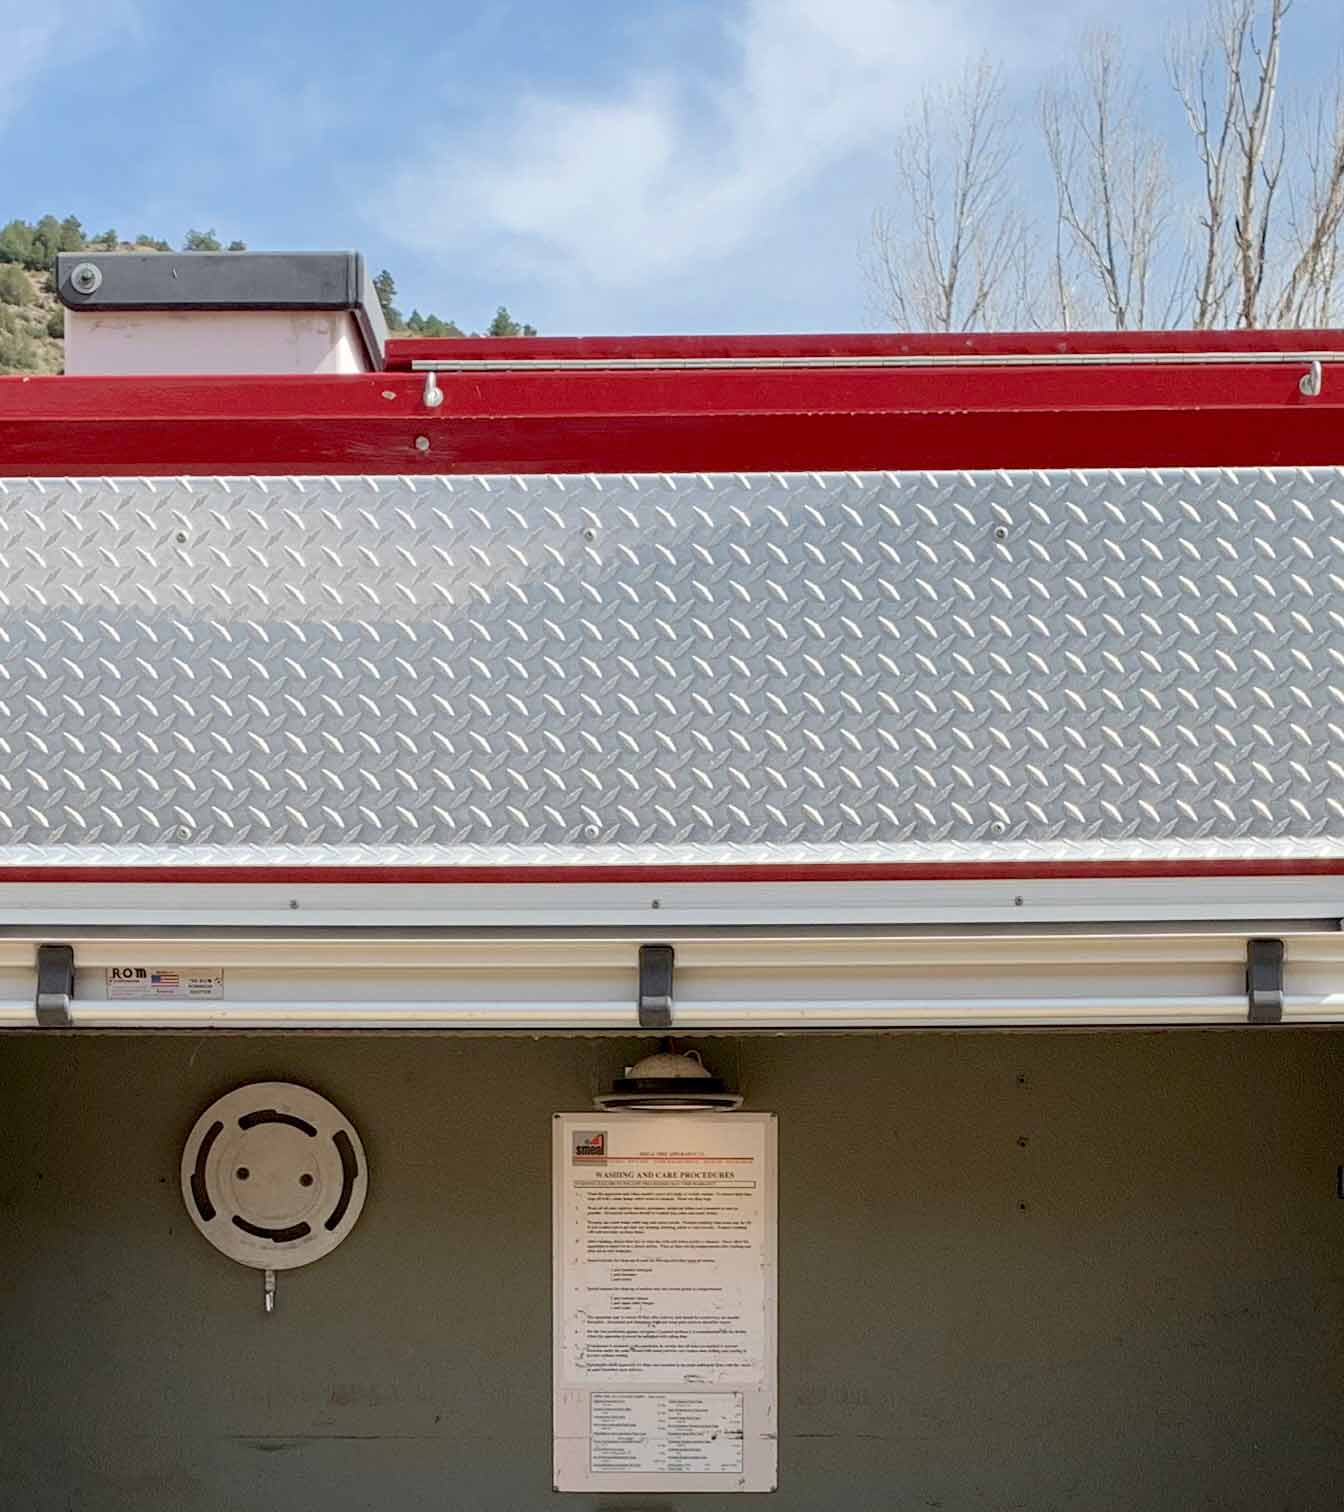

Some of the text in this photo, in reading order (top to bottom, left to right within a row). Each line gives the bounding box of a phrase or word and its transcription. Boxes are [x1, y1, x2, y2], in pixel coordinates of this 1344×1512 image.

[637, 1171, 655, 1179] AND
[656, 1171, 678, 1179] CARE
[680, 1171, 735, 1179] PROCEDURES
